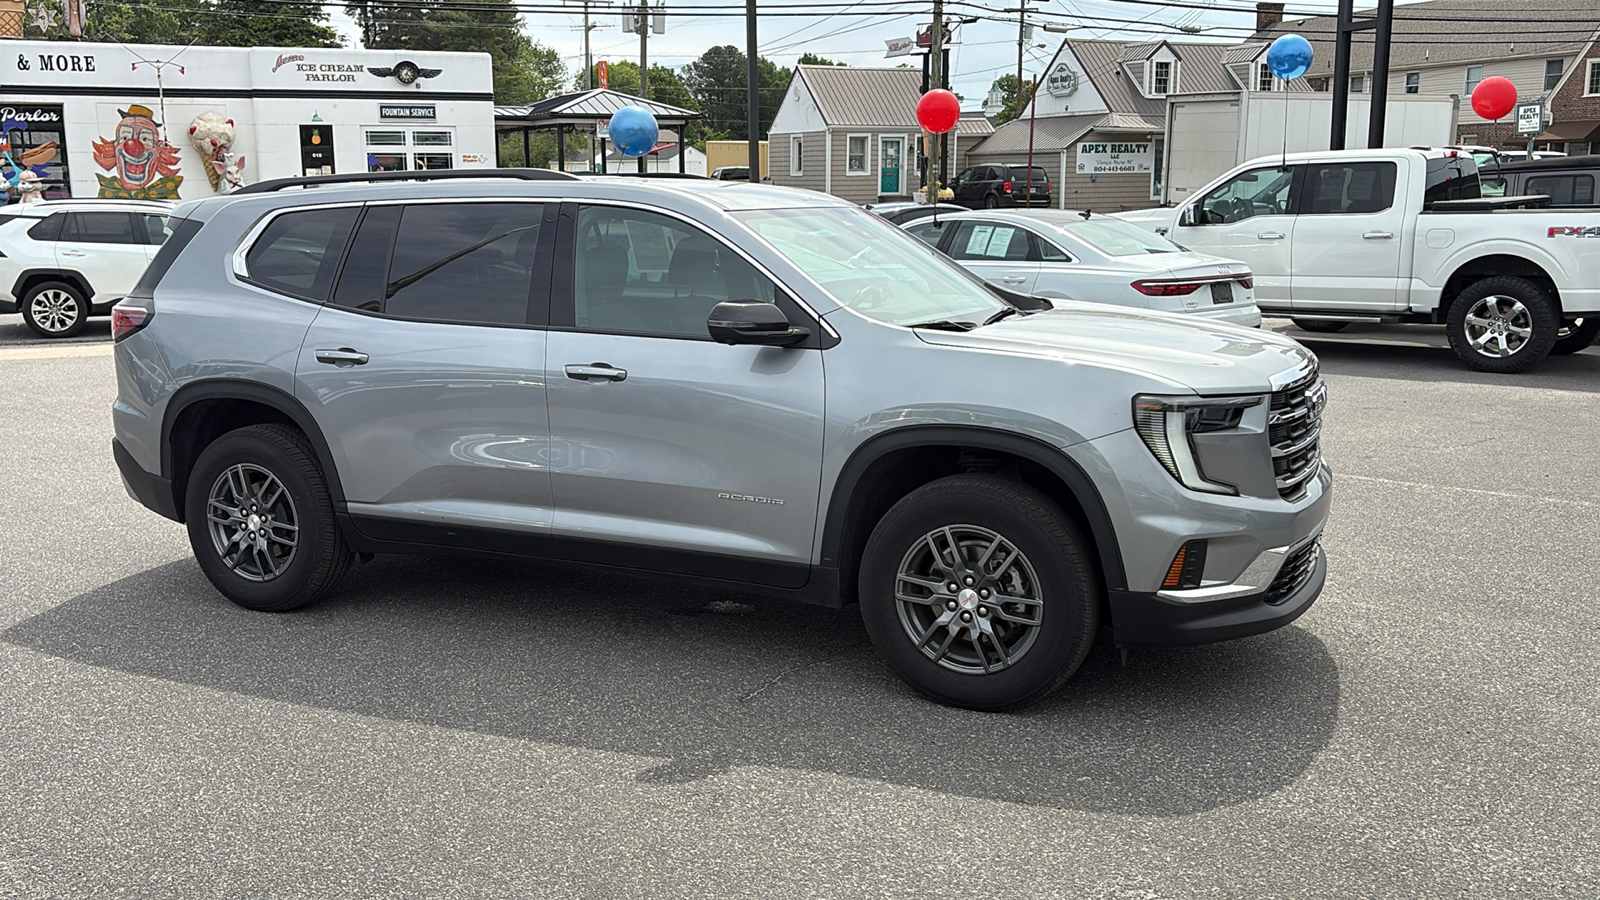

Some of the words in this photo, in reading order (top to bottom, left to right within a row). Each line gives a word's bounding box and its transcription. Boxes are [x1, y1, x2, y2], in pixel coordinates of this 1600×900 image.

[17, 53, 31, 71] &
[38, 54, 96, 72] MORE
[296, 63, 317, 72] ICE
[319, 64, 364, 73] CREAM
[305, 73, 356, 82] PARLOR
[0, 107, 60, 122] Parlor
[382, 108, 410, 117] FOUNTAIN
[411, 108, 434, 117] SERVICE
[1081, 144, 1108, 154] APEX
[1110, 144, 1149, 154] REALTY
[1546, 226, 1600, 238] FX4
[717, 492, 785, 506] ACADIA
